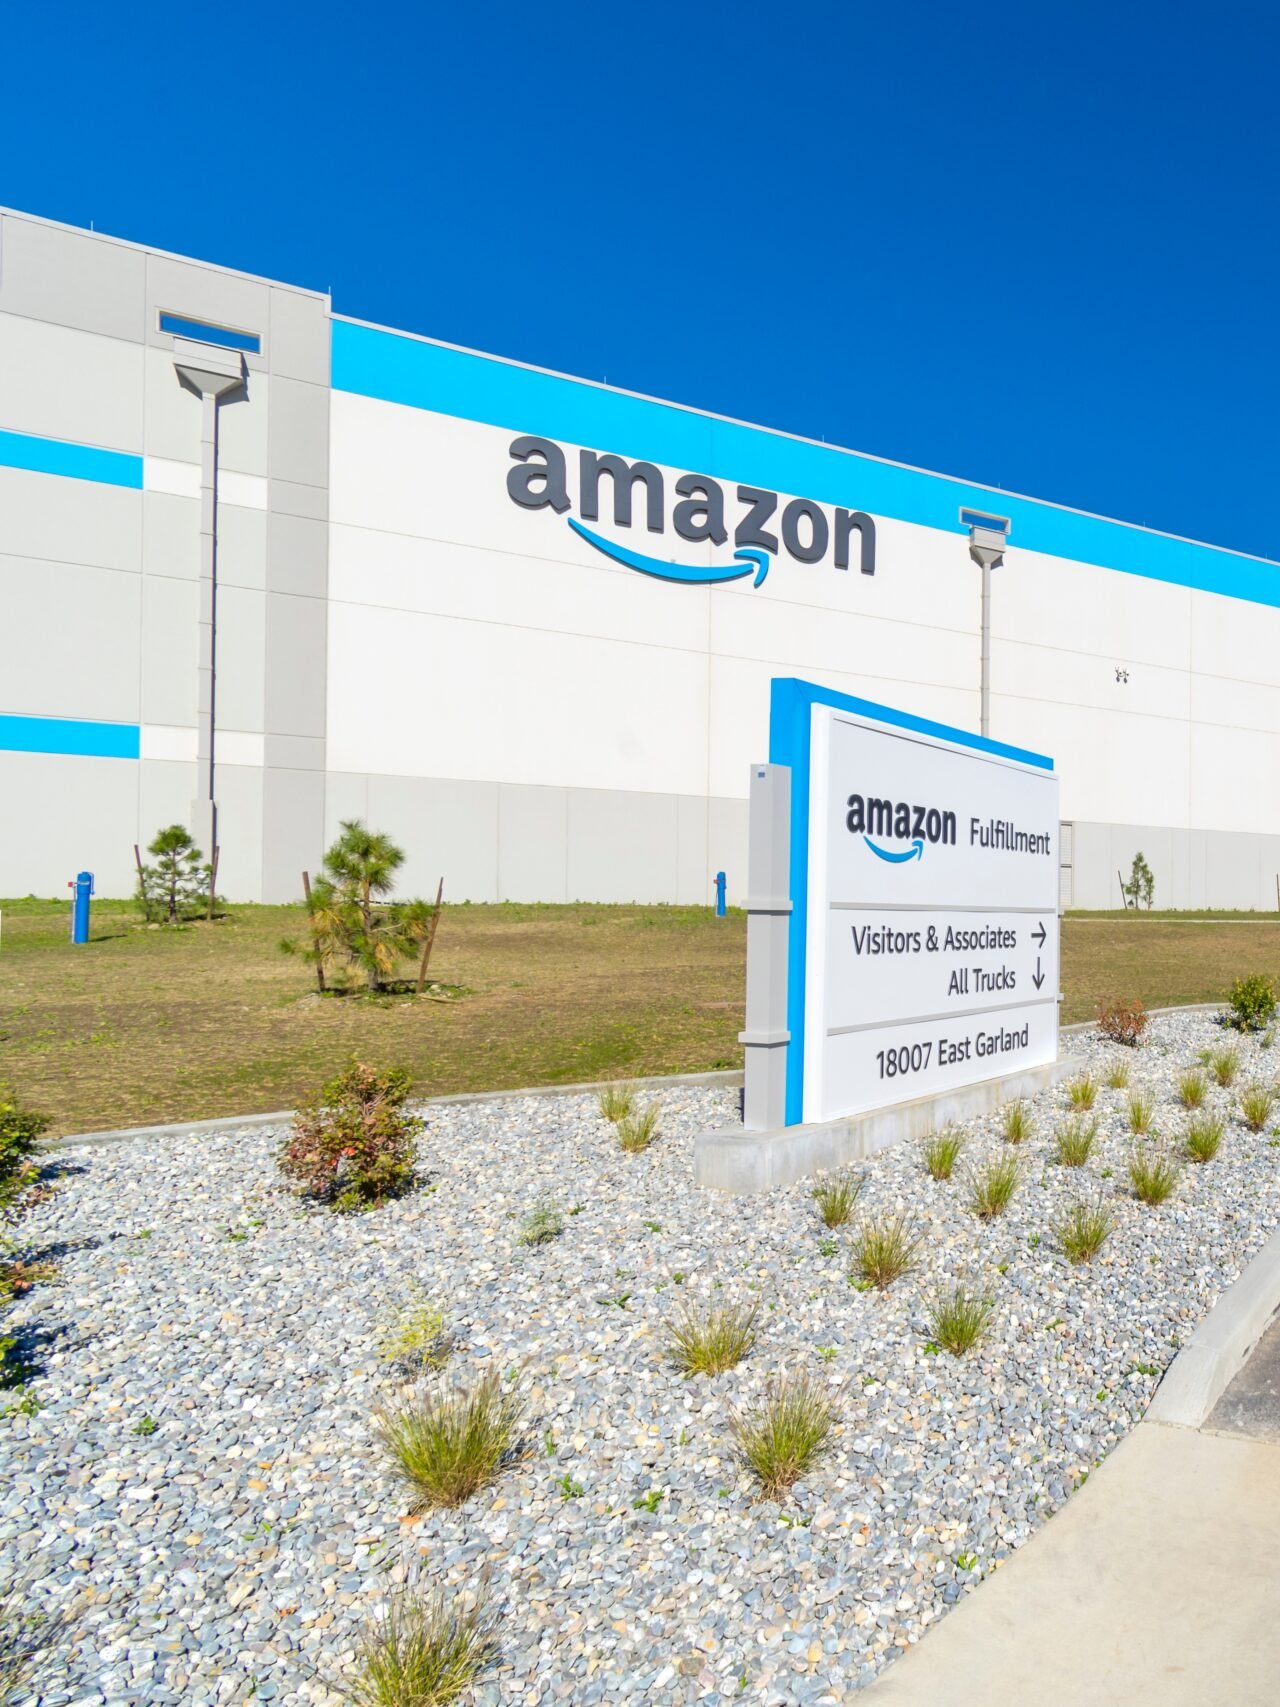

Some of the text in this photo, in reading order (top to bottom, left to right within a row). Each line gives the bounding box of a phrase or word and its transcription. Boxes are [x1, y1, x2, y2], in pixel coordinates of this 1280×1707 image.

[506, 435, 876, 576] amazon
[846, 793, 1051, 856] amazon Fulfillment
[851, 924, 1017, 956] Visitors & Associates
[947, 965, 1016, 996] All Trucks
[876, 1022, 1029, 1080] 18007 East Garland
